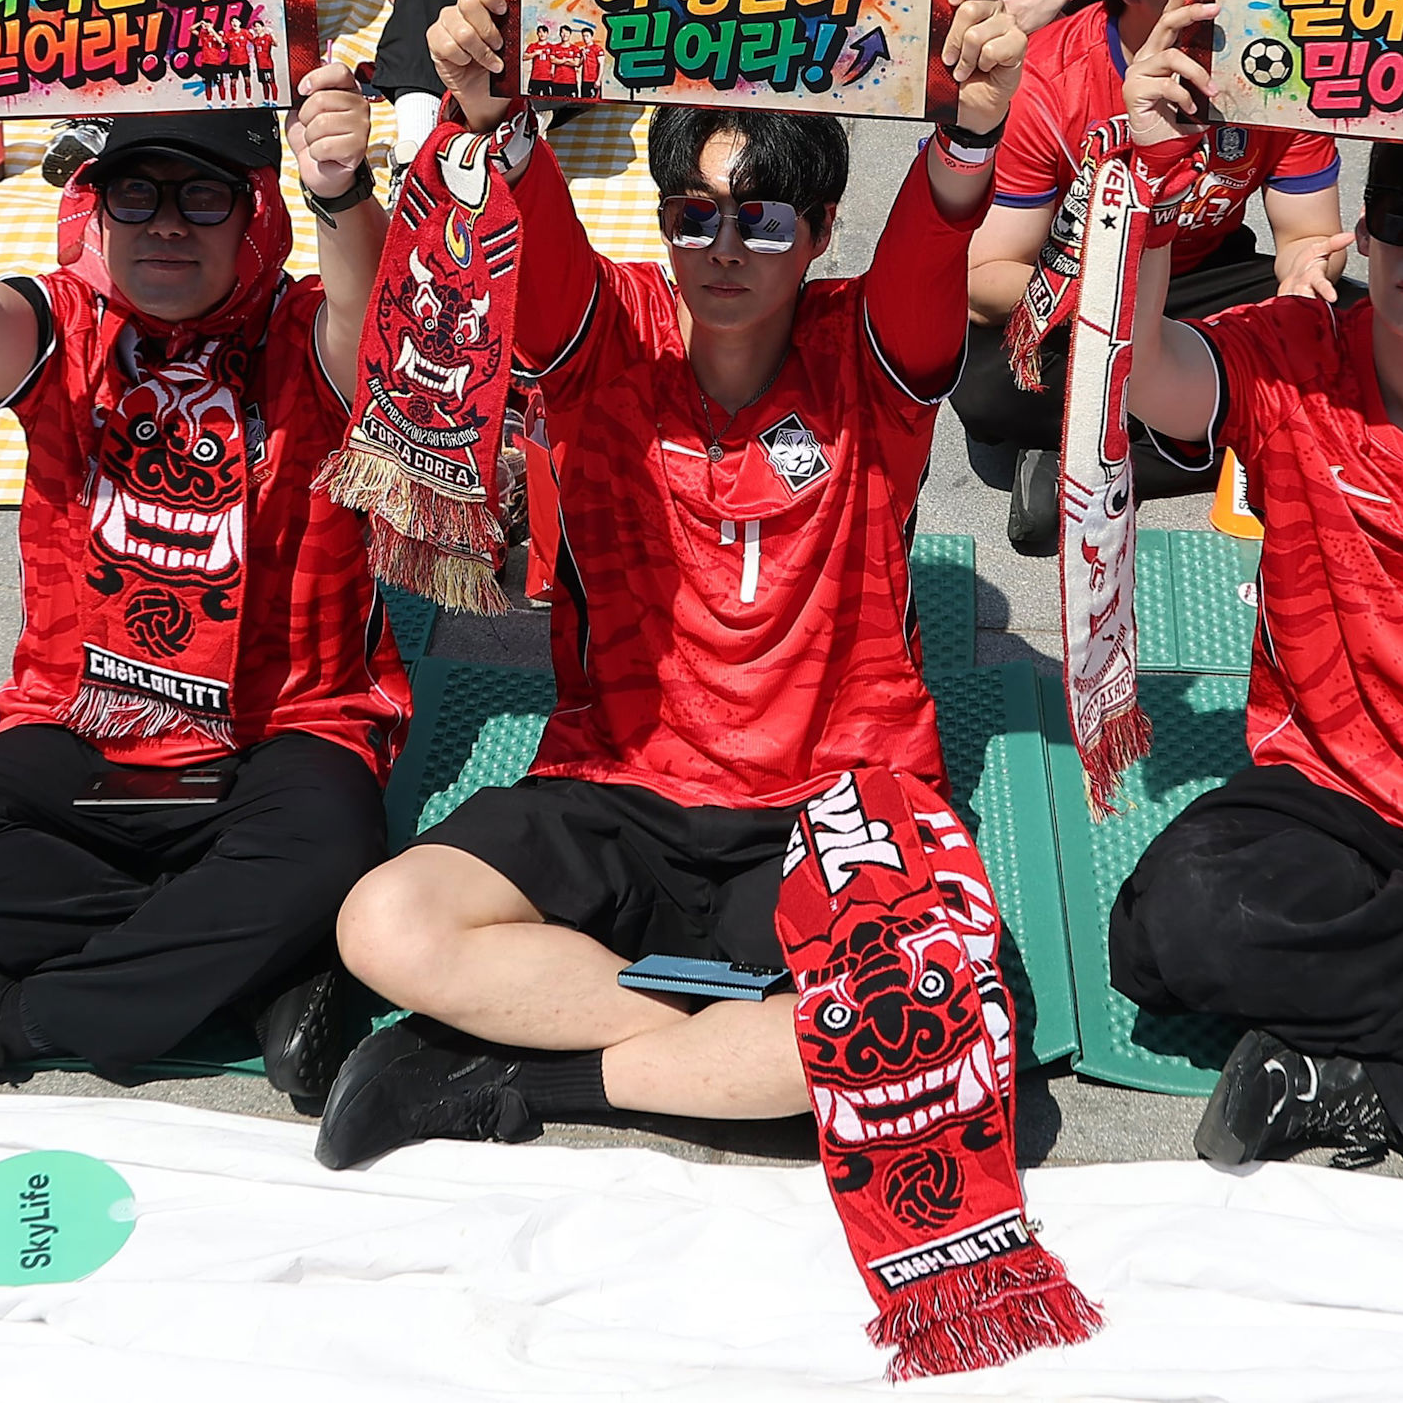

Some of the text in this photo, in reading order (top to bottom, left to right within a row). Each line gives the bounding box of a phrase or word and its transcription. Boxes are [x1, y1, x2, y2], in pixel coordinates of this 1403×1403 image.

[604, 9, 840, 84] 믿어라!
[367, 421, 472, 487] FORZA COREA
[19, 1172, 50, 1270] SkyLife
